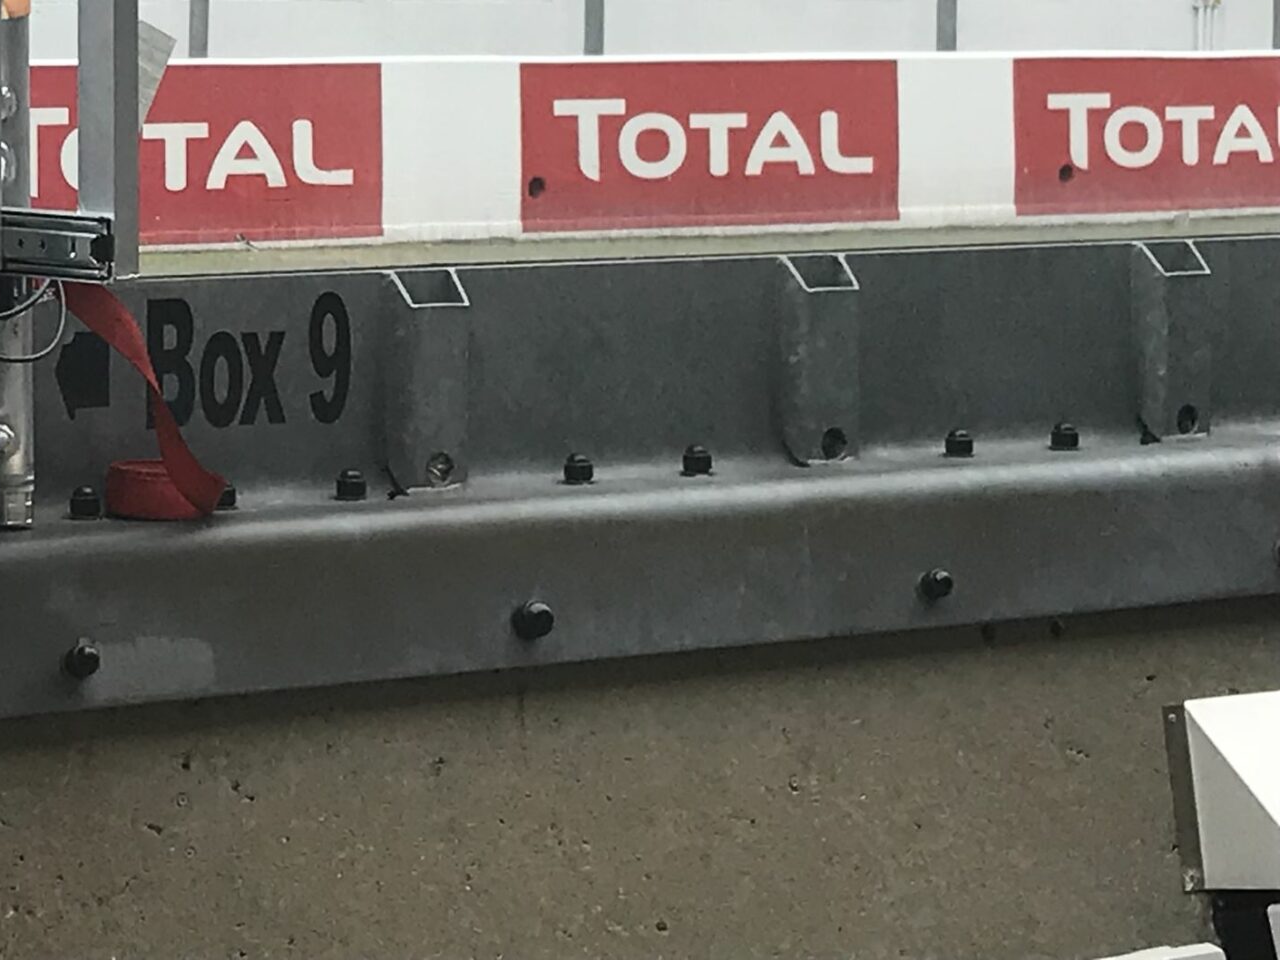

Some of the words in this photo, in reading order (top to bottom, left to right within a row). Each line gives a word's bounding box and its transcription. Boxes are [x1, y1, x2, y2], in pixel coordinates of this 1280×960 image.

[553, 98, 874, 181] TOTAL
[1047, 93, 1280, 171] TOTA
[146, 297, 286, 430] Box
[308, 291, 352, 424] 9
